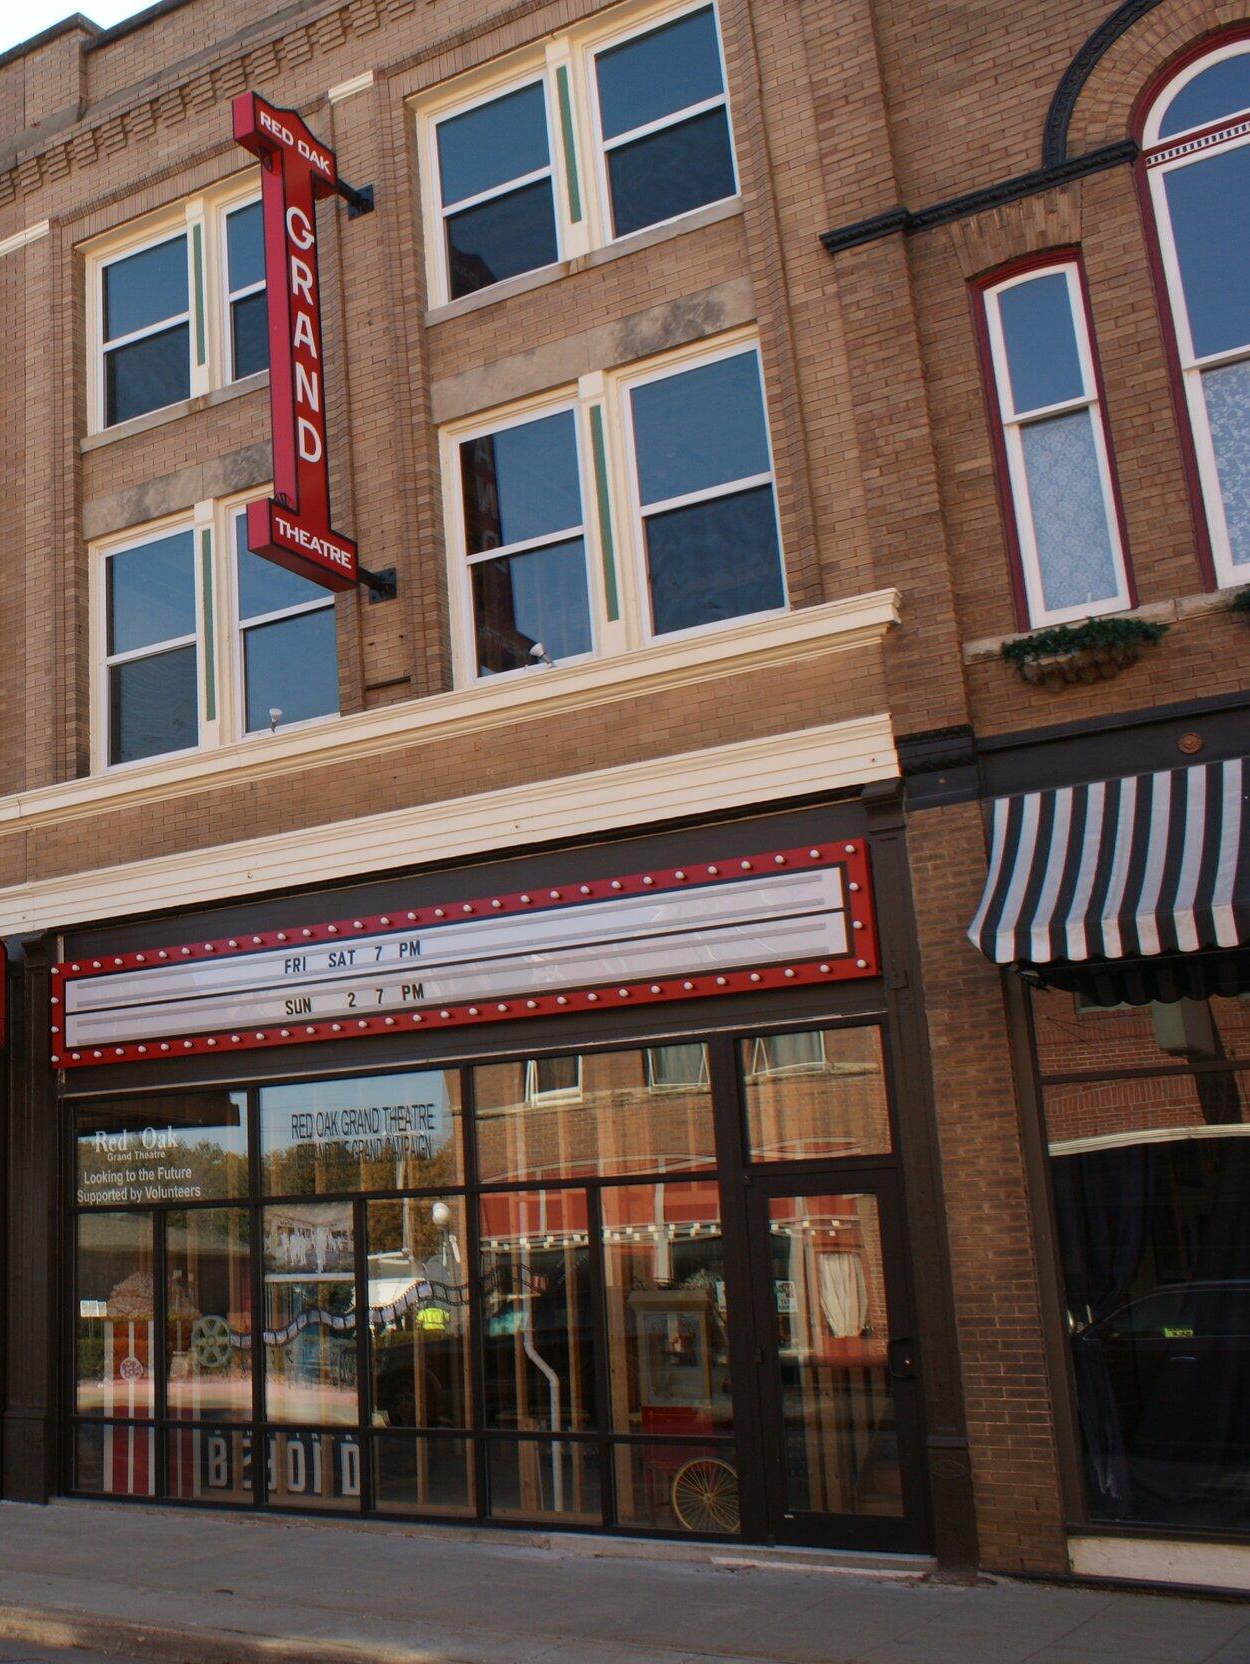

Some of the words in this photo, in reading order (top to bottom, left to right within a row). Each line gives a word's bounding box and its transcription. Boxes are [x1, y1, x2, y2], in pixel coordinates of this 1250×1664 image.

[260, 111, 294, 146] RED
[297, 140, 331, 175] OAK
[285, 205, 323, 464] GRAND
[275, 516, 352, 569] THEATRE
[284, 956, 306, 974] FRI
[328, 950, 356, 968] SAT
[375, 946, 382, 961] 7
[400, 940, 421, 958] PM
[285, 998, 312, 1015] SUN
[347, 992, 356, 1008] 2
[376, 988, 384, 1004] 7
[402, 983, 424, 1001] PM
[291, 1113, 313, 1139] RED
[316, 1111, 339, 1137] OAK
[341, 1108, 380, 1135] GRAND
[383, 1103, 436, 1132] THEATRE
[95, 1128, 128, 1152] Red
[142, 1125, 179, 1149] Oak
[352, 1138, 382, 1163] GRAND
[385, 1134, 433, 1163] CAMPAIGN
[107, 1152, 132, 1162] Grand
[134, 1150, 166, 1160] Theatre
[84, 1171, 123, 1185] Looking
[126, 1170, 136, 1180] to
[138, 1168, 155, 1180] the
[158, 1166, 192, 1180] Future
[77, 1187, 127, 1205] Supported
[130, 1188, 142, 1203] by
[145, 1185, 201, 1200] Volunteers
